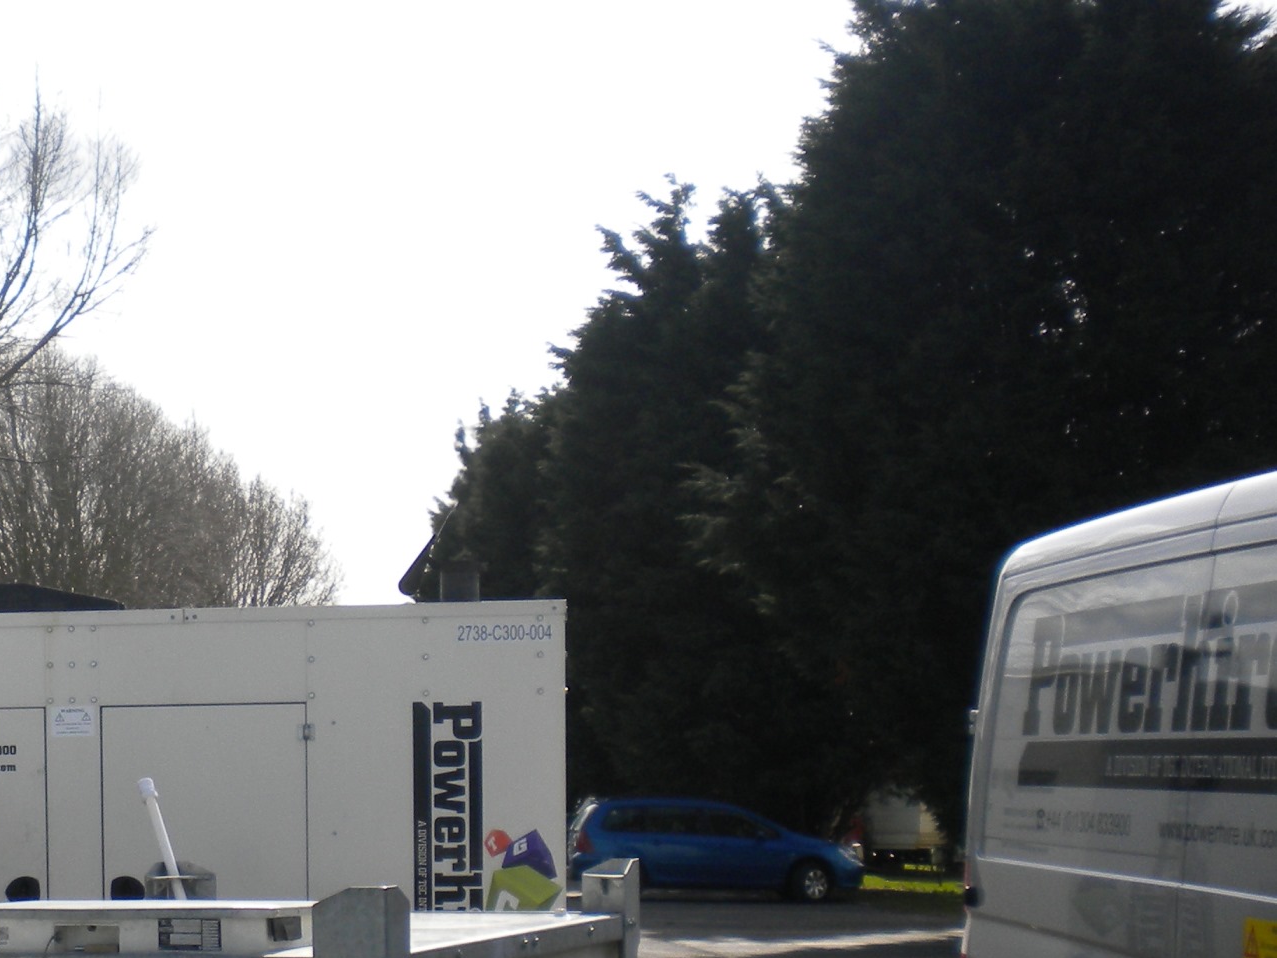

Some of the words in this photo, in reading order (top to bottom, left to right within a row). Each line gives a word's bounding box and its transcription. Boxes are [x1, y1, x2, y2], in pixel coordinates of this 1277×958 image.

[457, 624, 552, 642] 2738-C300-004
[433, 702, 482, 912] Powerh
[417, 820, 427, 828] A
[417, 829, 427, 866] DIVISION
